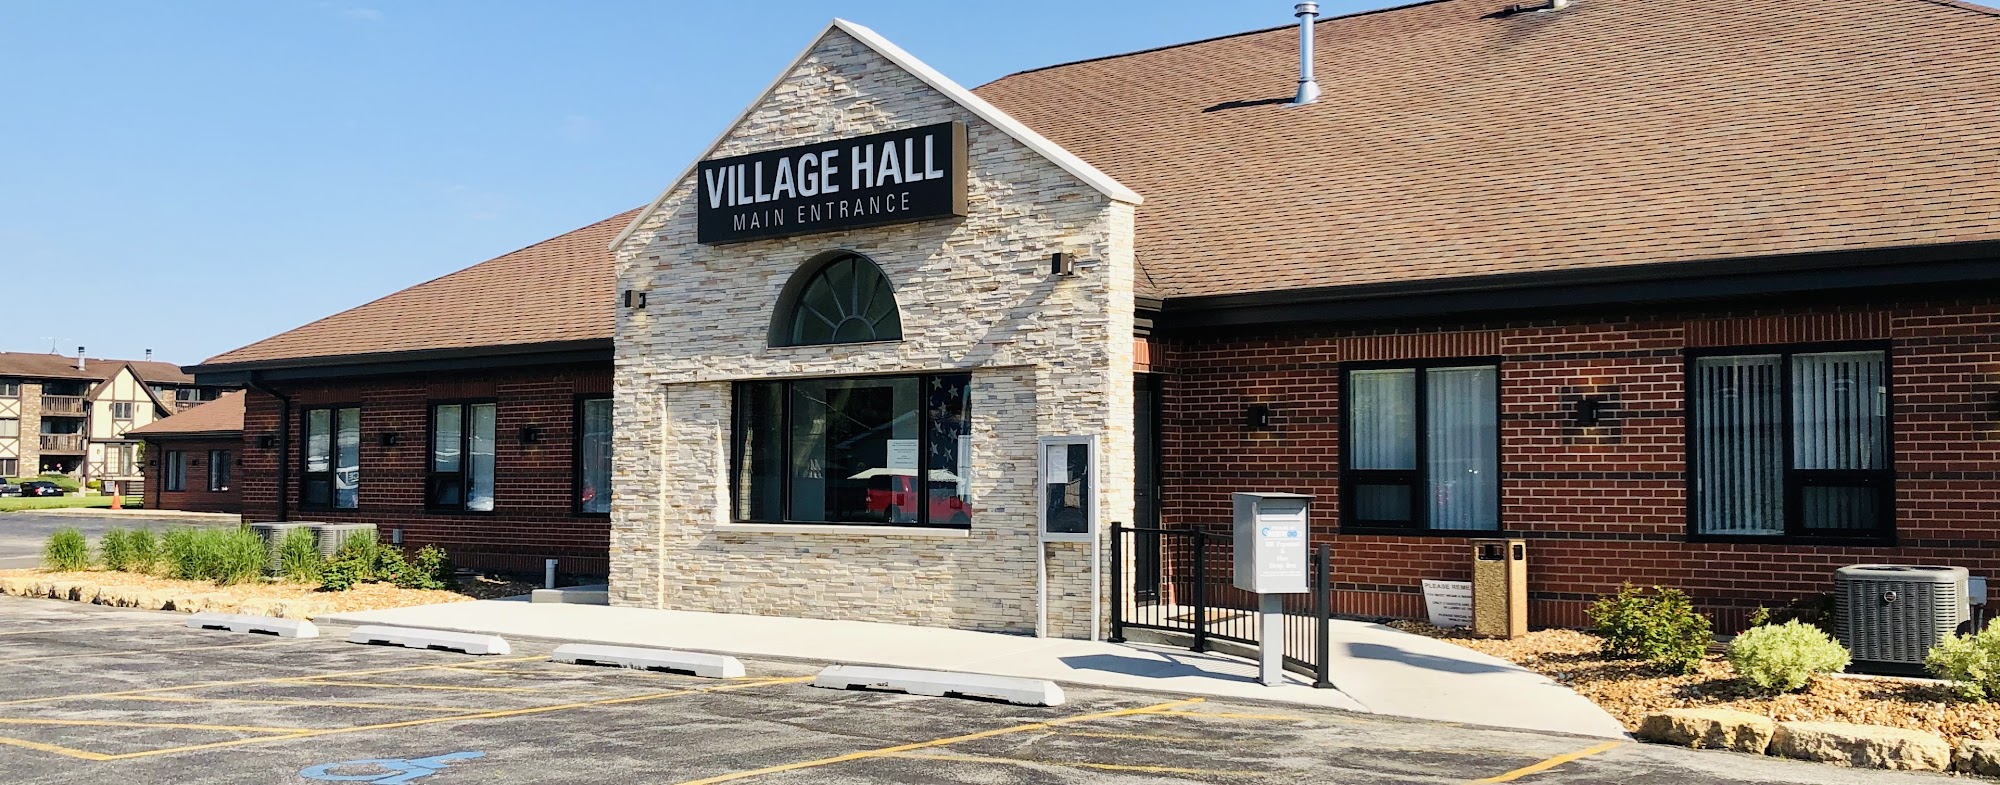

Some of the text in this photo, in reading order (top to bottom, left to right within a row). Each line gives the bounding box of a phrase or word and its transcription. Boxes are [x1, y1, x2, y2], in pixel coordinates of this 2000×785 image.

[705, 134, 944, 209] VILLAGE HALL
[733, 191, 910, 232] MAIN ENTRANCE
